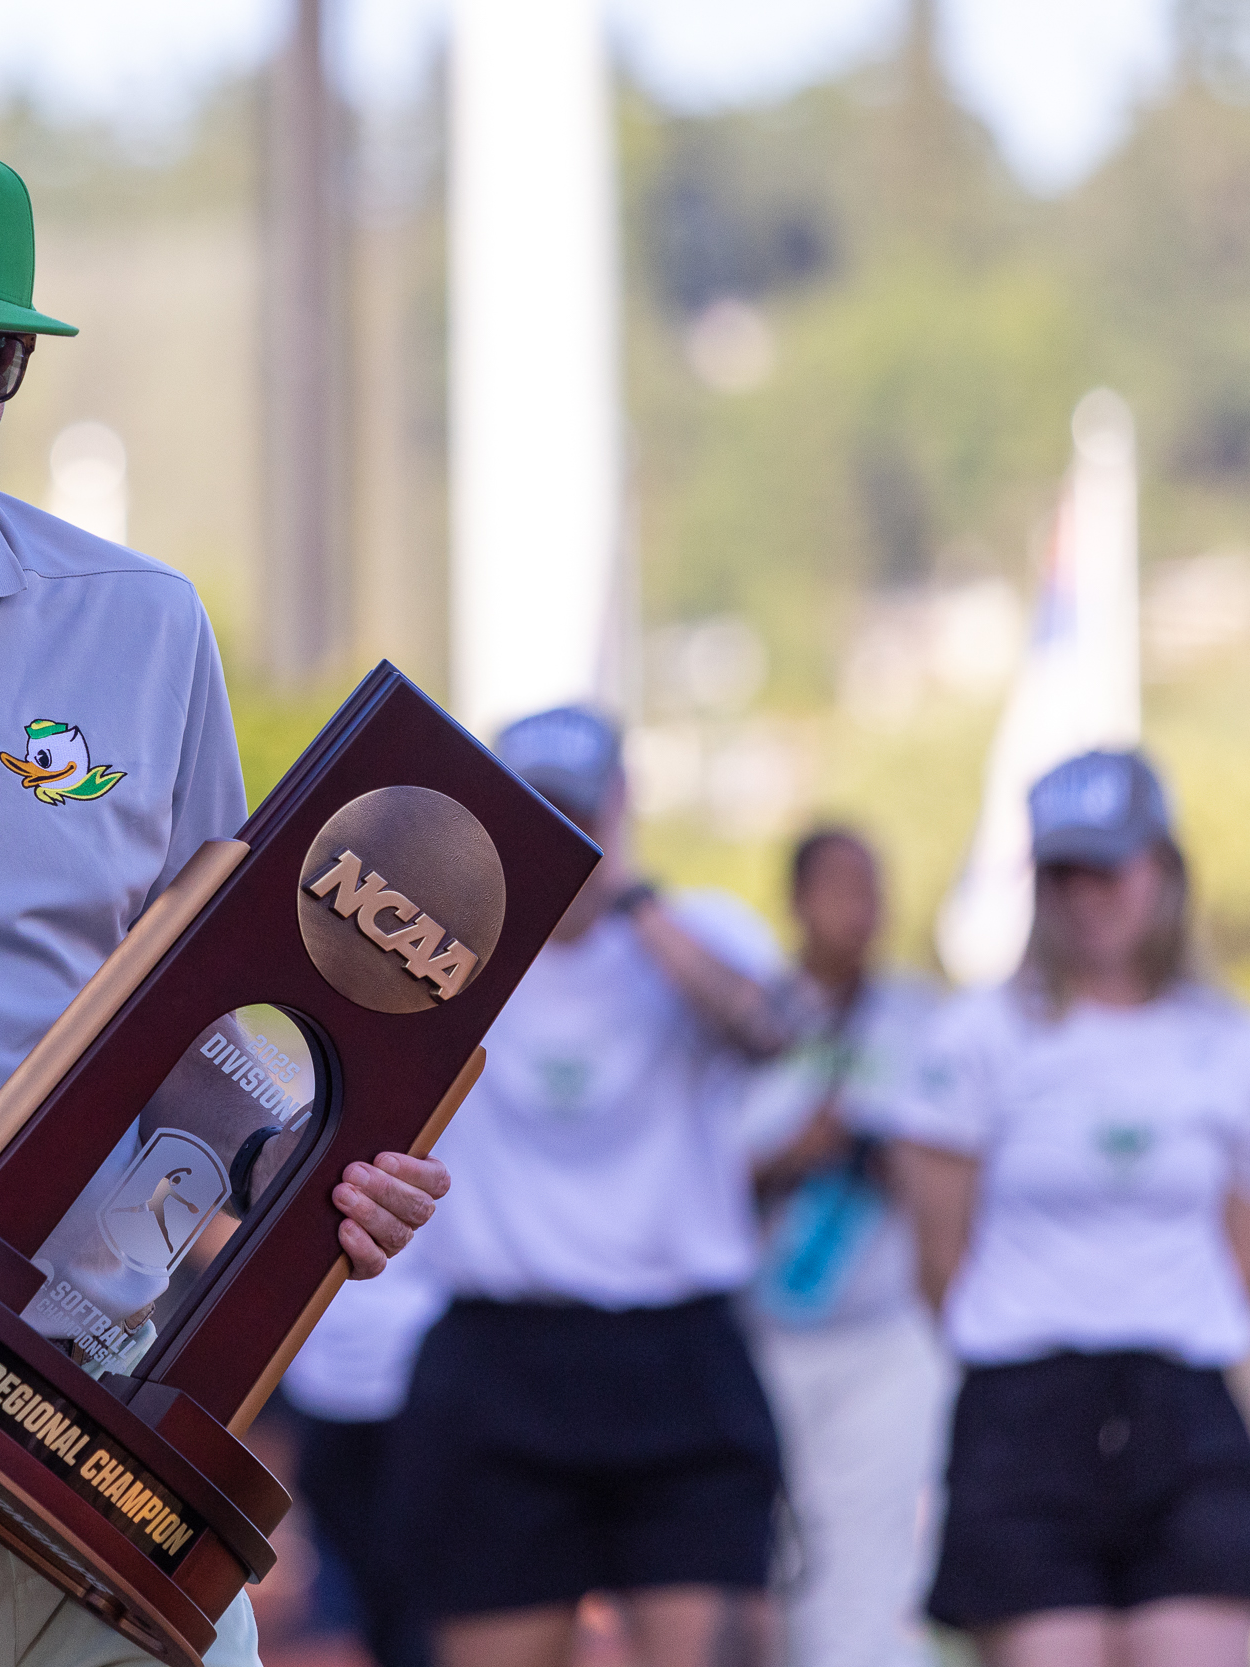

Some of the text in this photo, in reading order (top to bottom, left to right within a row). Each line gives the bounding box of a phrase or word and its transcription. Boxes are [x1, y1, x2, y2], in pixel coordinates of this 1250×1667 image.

[304, 849, 479, 1001] NCAA
[200, 1032, 312, 1132] DIVISION I
[246, 1034, 301, 1083] 2025
[50, 1281, 136, 1359] SOFTBALL
[79, 1449, 194, 1557] CHAMPION
